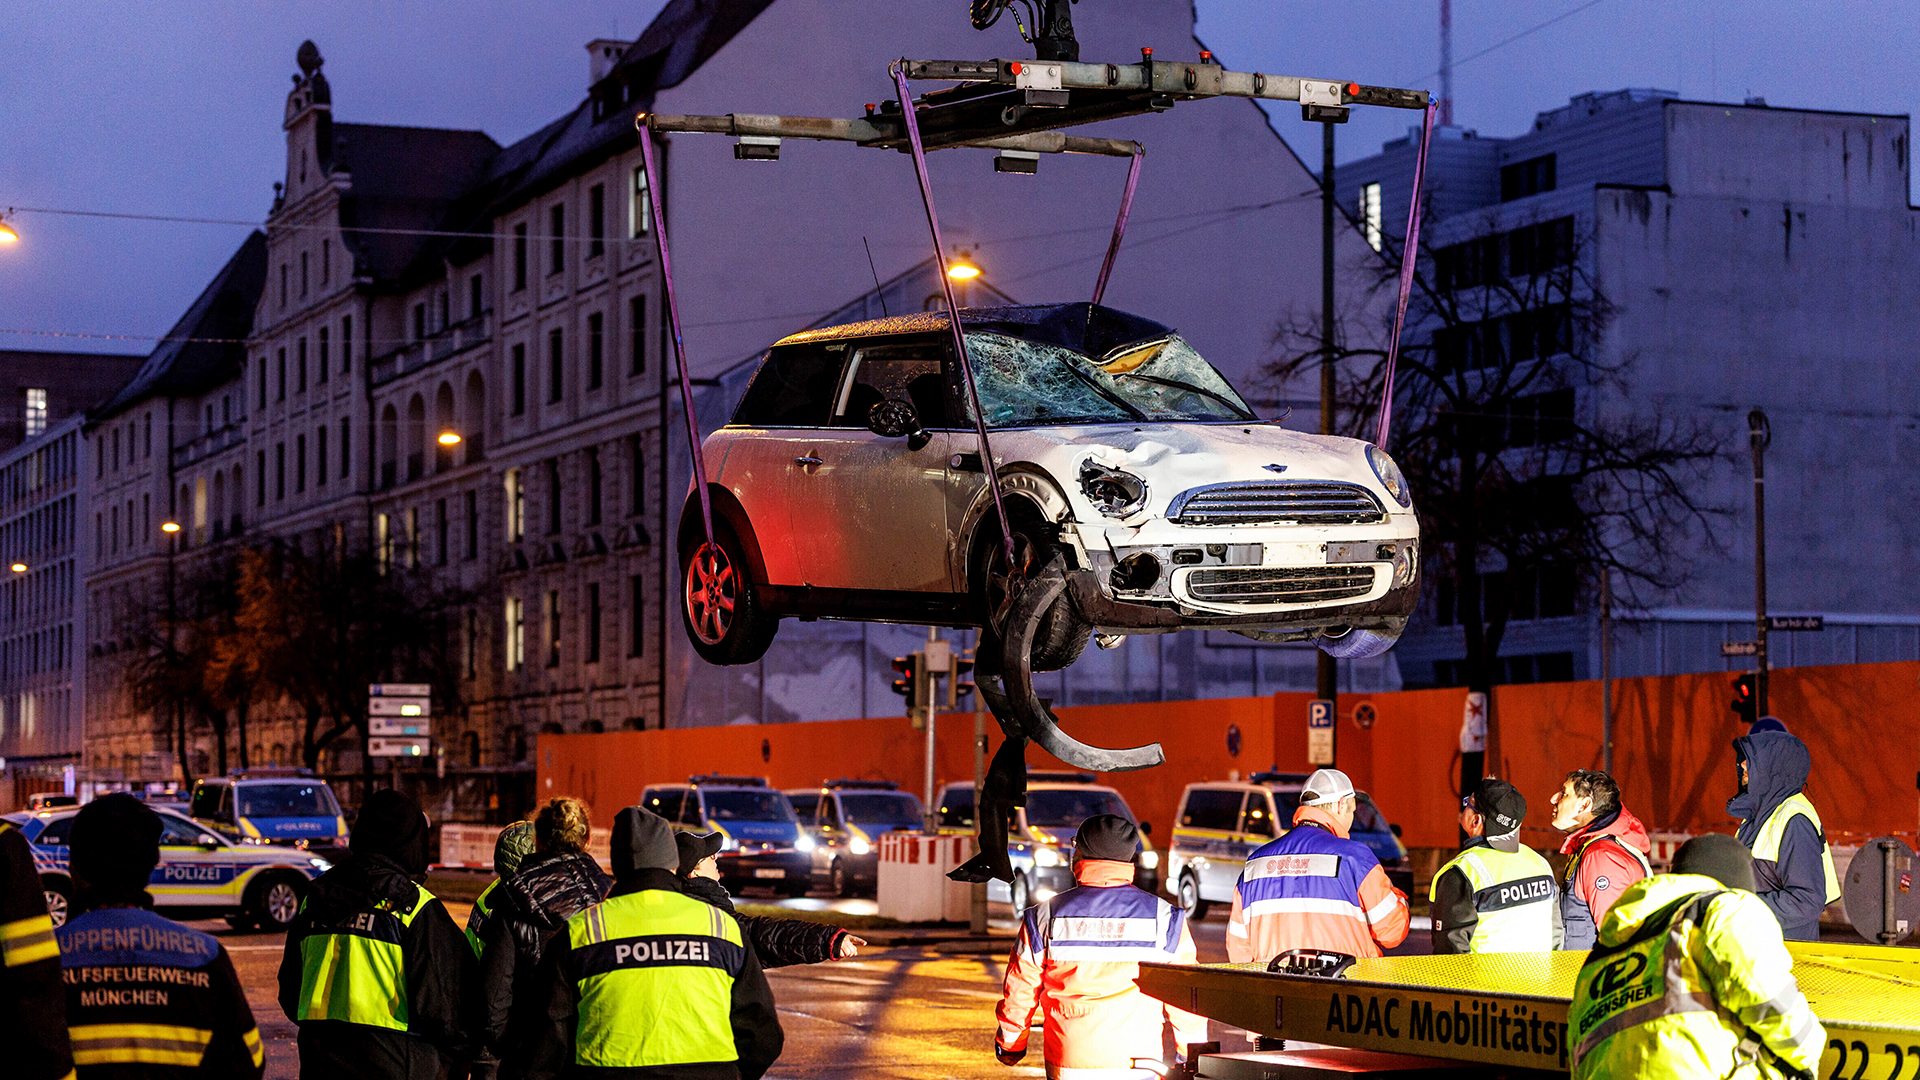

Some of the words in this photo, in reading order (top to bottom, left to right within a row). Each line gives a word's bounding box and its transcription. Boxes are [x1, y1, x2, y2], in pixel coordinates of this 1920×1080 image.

[1496, 813, 1511, 827] SK
[1511, 819, 1517, 829] 1
[165, 867, 220, 880] POLIZEI
[1500, 879, 1551, 904] POLIZEI
[59, 925, 209, 956] UPPENFÜHRER
[615, 941, 709, 964] POLIZEI
[62, 966, 210, 988] RUFSFEUERWEHR
[80, 987, 169, 1007] MÜNCHEN
[1326, 993, 1400, 1038] ADAC
[1409, 999, 1568, 1069] Mobilitätsp
